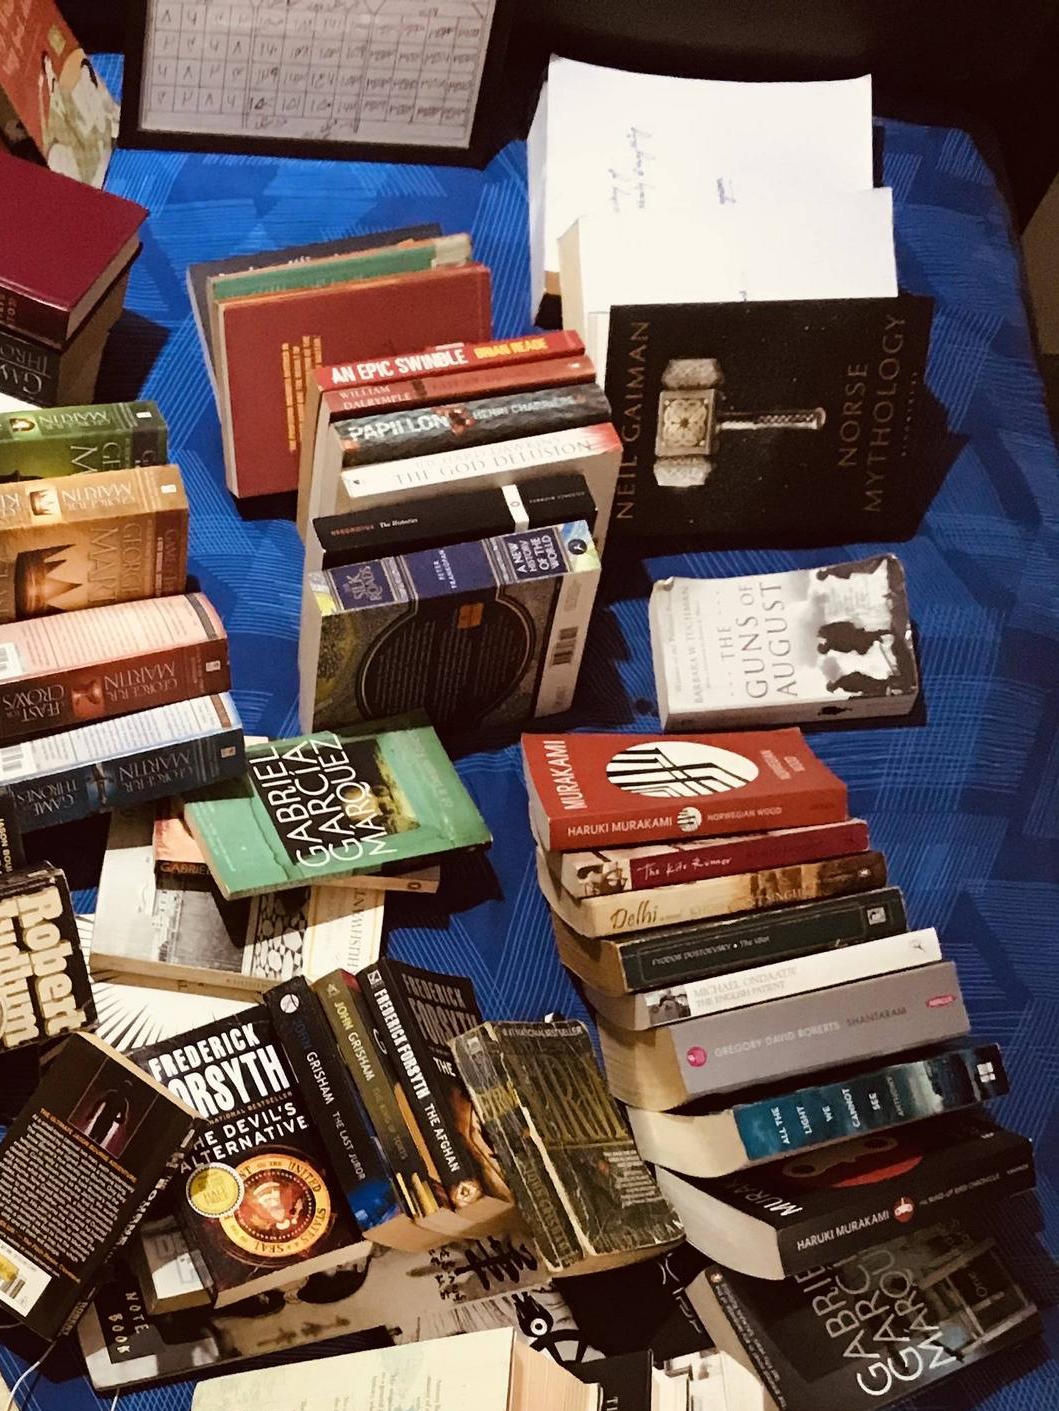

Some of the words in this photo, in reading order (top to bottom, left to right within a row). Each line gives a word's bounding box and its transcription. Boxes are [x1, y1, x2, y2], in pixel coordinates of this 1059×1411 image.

[331, 365, 357, 384] AN
[360, 360, 394, 380] EPIC
[625, 322, 649, 440] GAIMAN
[349, 416, 451, 441] PAPILLON
[838, 363, 868, 466] NORSE
[865, 315, 905, 512] MYTHOLOGY
[396, 472, 430, 487] THE
[440, 460, 486, 478] GOD
[492, 440, 592, 469] DELUSION
[618, 454, 638, 518] NEIL
[739, 585, 754, 608] OF
[718, 626, 735, 660] THE
[736, 616, 768, 699] GUNS
[760, 582, 799, 698] AUGUST
[278, 739, 364, 862] GARCÍA
[309, 730, 397, 857] MÁRQUEZ
[543, 740, 587, 810] MURAKAMI
[249, 745, 330, 869] GABRIEL
[567, 823, 609, 837] HARUKI
[612, 816, 673, 833] MURAKAMI
[609, 901, 658, 929] Delhi
[17, 885, 87, 1036] Robert
[402, 973, 468, 1008] FREDERICK
[148, 1023, 261, 1082] FREDERICK
[334, 1001, 354, 1031] JOHN
[348, 1031, 375, 1081] GRISHAM
[715, 1039, 762, 1058] GREGORY
[765, 1031, 796, 1047] DAVID
[798, 1021, 841, 1039] ROBERTS
[167, 1045, 290, 1118] ORSYTH
[306, 1051, 335, 1105] GRISHAM
[374, 988, 408, 1048] FREDERICK
[396, 1044, 431, 1100] FORSYTH
[425, 1103, 440, 1127] THE
[433, 1125, 460, 1173] AFGHAN
[222, 1102, 297, 1138] DEVIL'S
[796, 1105, 813, 1136] LIGHT
[843, 1088, 860, 1128] CANNOT
[180, 1115, 308, 1174] ALTERNATIVE
[796, 1228, 835, 1250] HARUKI
[835, 1211, 890, 1238] MURAKAMI
